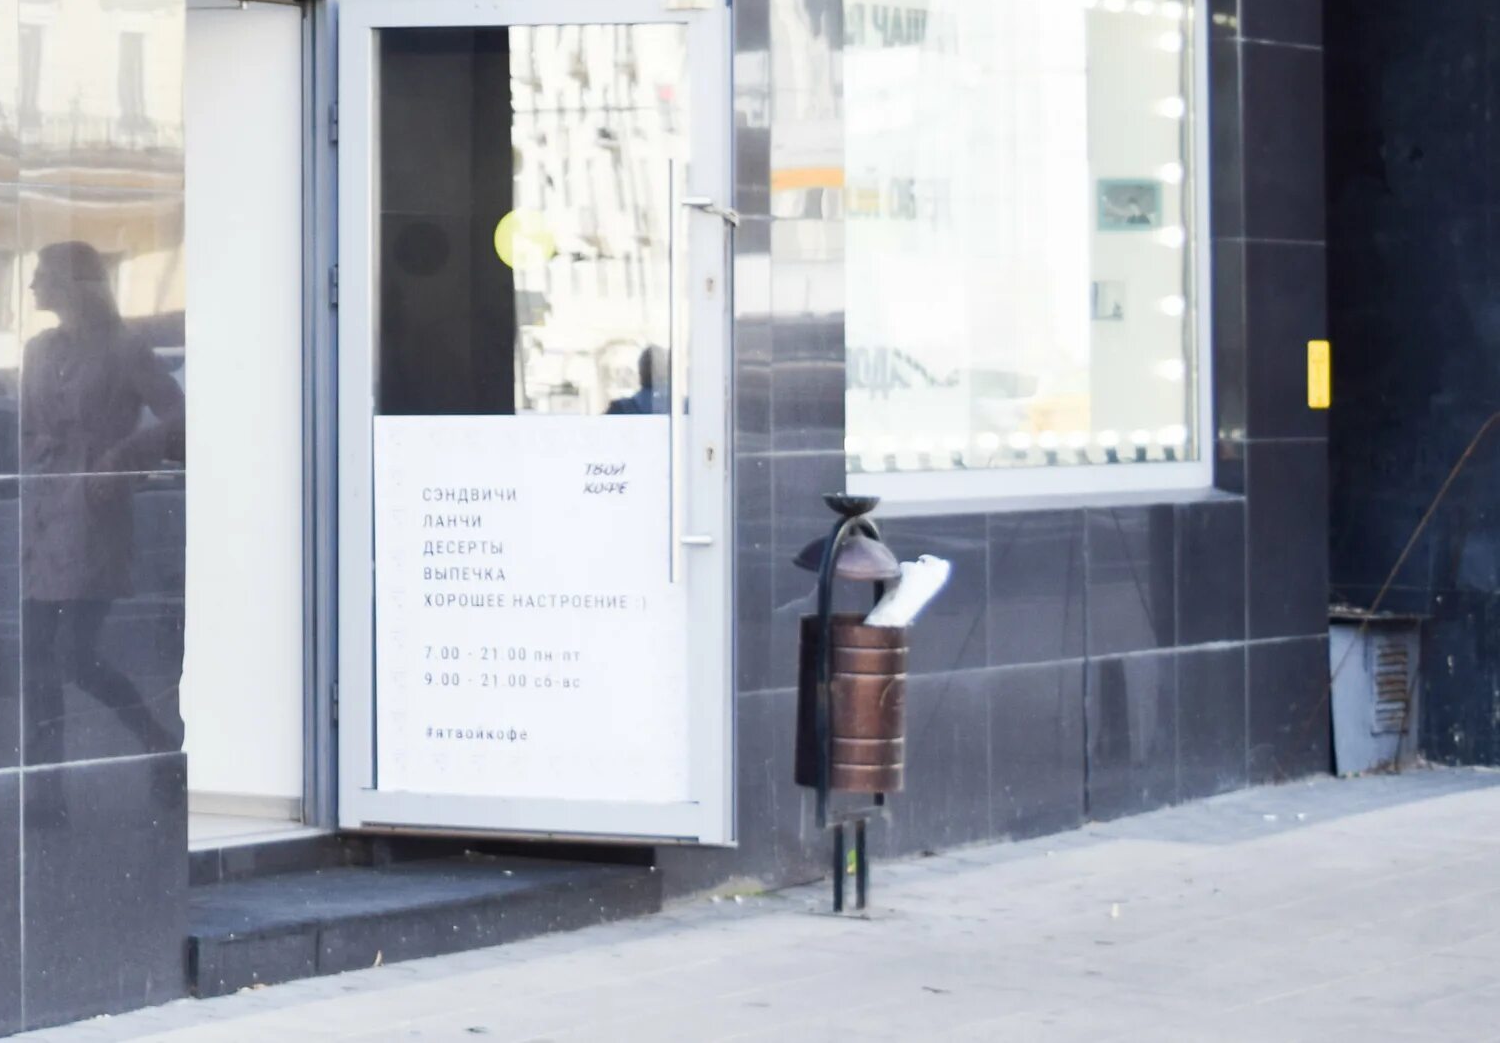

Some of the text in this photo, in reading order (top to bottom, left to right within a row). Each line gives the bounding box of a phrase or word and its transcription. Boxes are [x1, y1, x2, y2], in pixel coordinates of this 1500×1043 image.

[422, 487, 517, 504] СЭНДВИЧИ
[422, 514, 483, 529] ЛАНЧИ
[422, 540, 504, 557] ДЕСЕРТЫ
[423, 567, 506, 582] ВЫПЕЧКА
[423, 593, 506, 608] ХОРОШЕЕ
[512, 594, 628, 610] НАСТРОЕНИЕ
[424, 646, 460, 661] 7.00
[480, 646, 527, 661] 21.00
[424, 672, 460, 687] 9.00
[480, 673, 527, 688] 21.00
